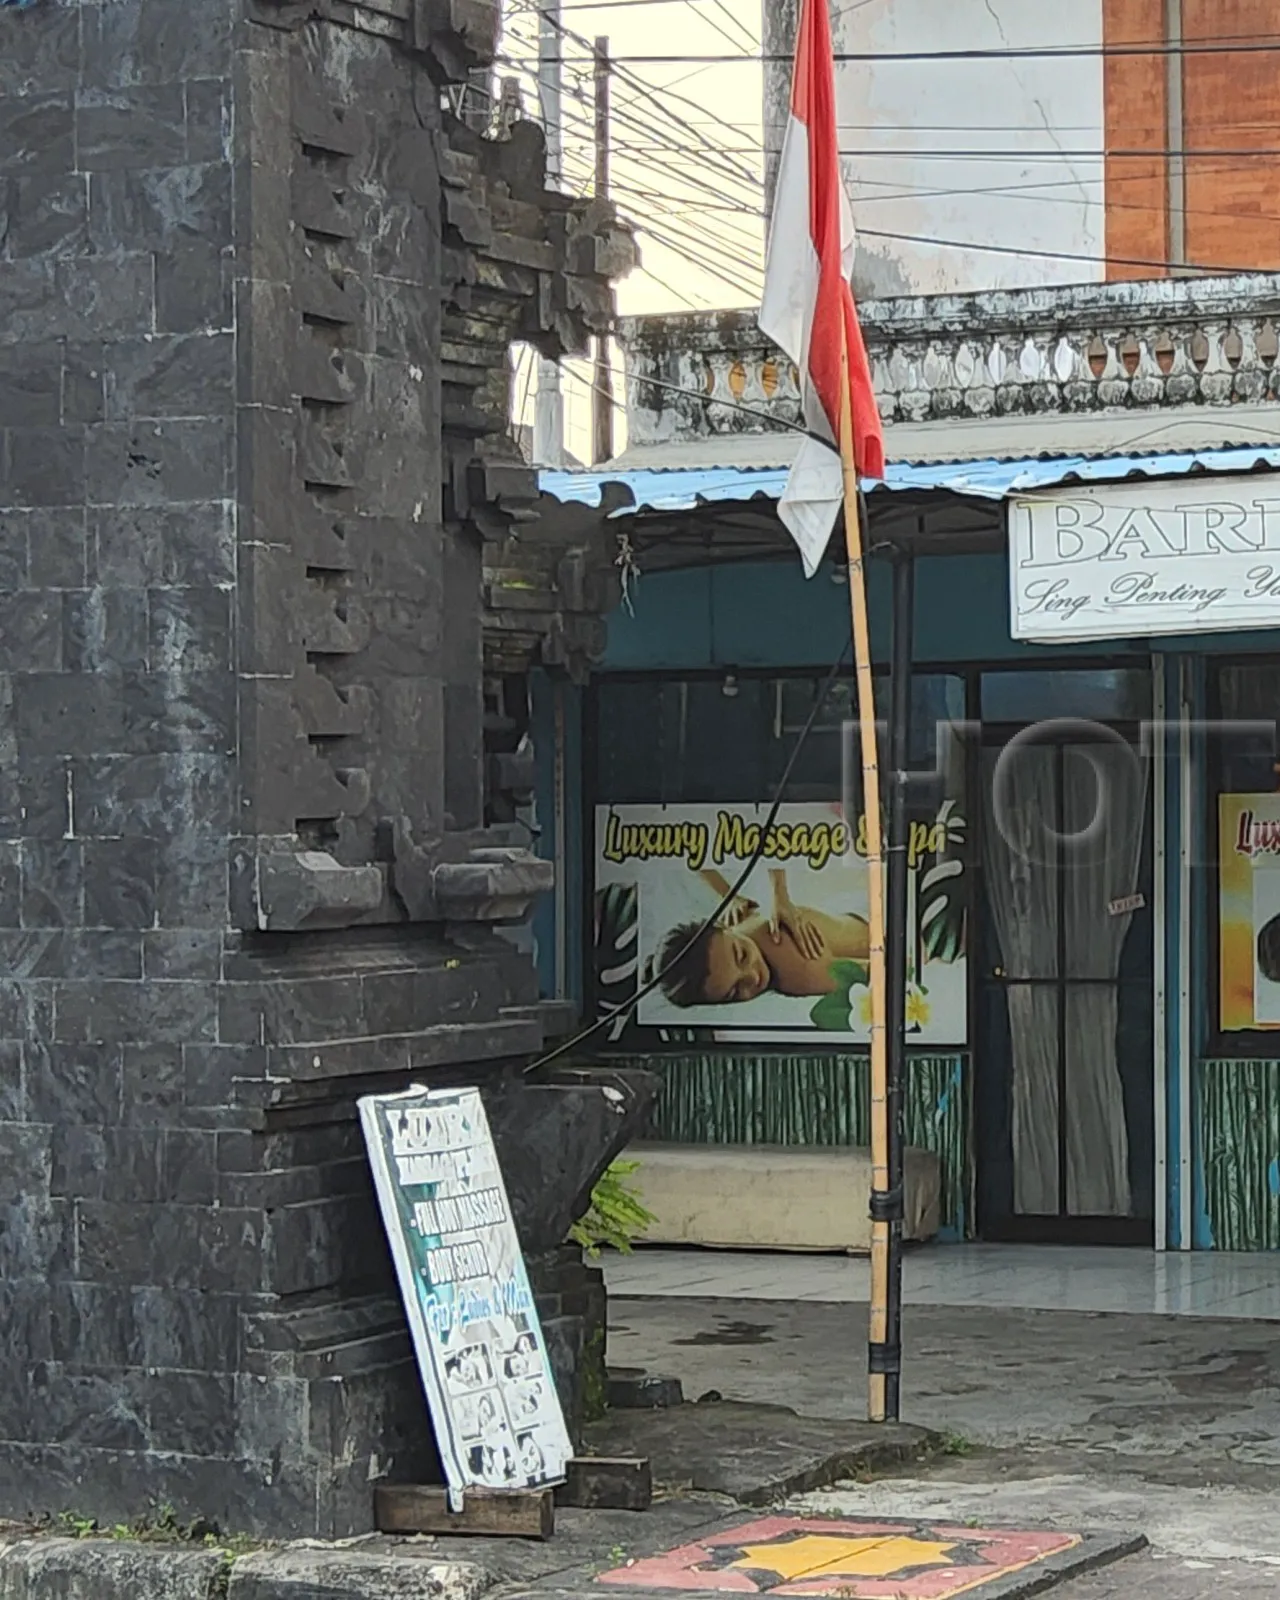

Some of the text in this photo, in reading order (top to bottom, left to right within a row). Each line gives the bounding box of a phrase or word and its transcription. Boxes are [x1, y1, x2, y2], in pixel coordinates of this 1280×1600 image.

[1018, 578, 1091, 620] Sing
[1104, 571, 1227, 610] Penting
[604, 813, 706, 869] Luxury
[713, 811, 848, 869] Massage
[907, 819, 947, 869] pa
[455, 1187, 506, 1232] MASSAGE
